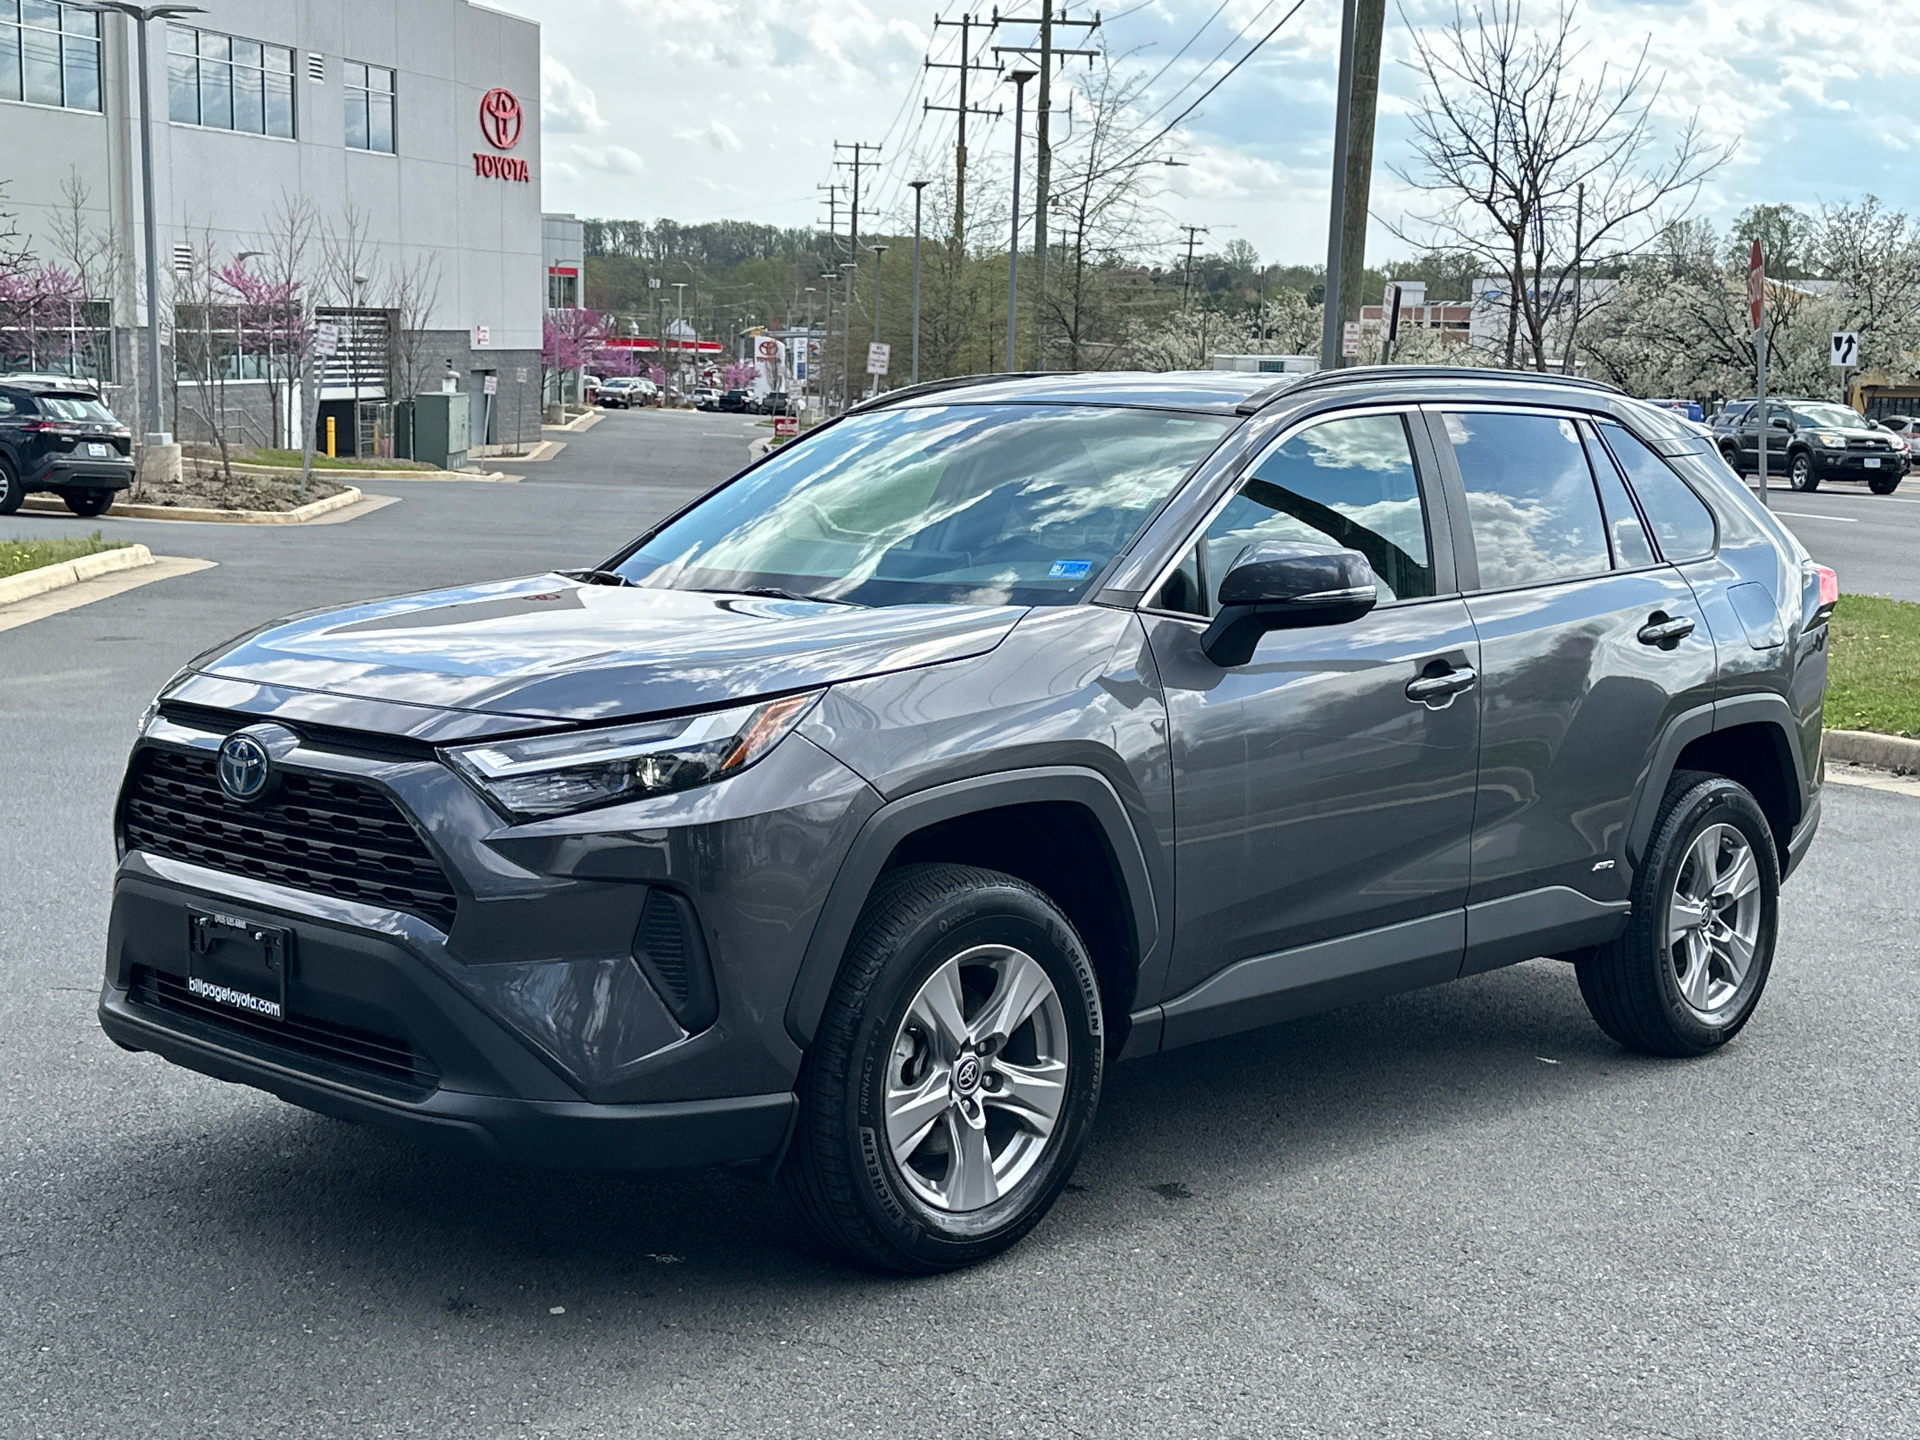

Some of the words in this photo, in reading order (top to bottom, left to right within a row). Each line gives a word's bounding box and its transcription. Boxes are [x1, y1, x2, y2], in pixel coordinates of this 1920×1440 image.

[472, 152, 529, 183] TOYOTA
[188, 976, 281, 1017] billpagetoyota.com
[1066, 946, 1100, 1032] MICHELIN
[860, 1052, 875, 1115] PRIMACY
[862, 1131, 900, 1221] MICHELIN
